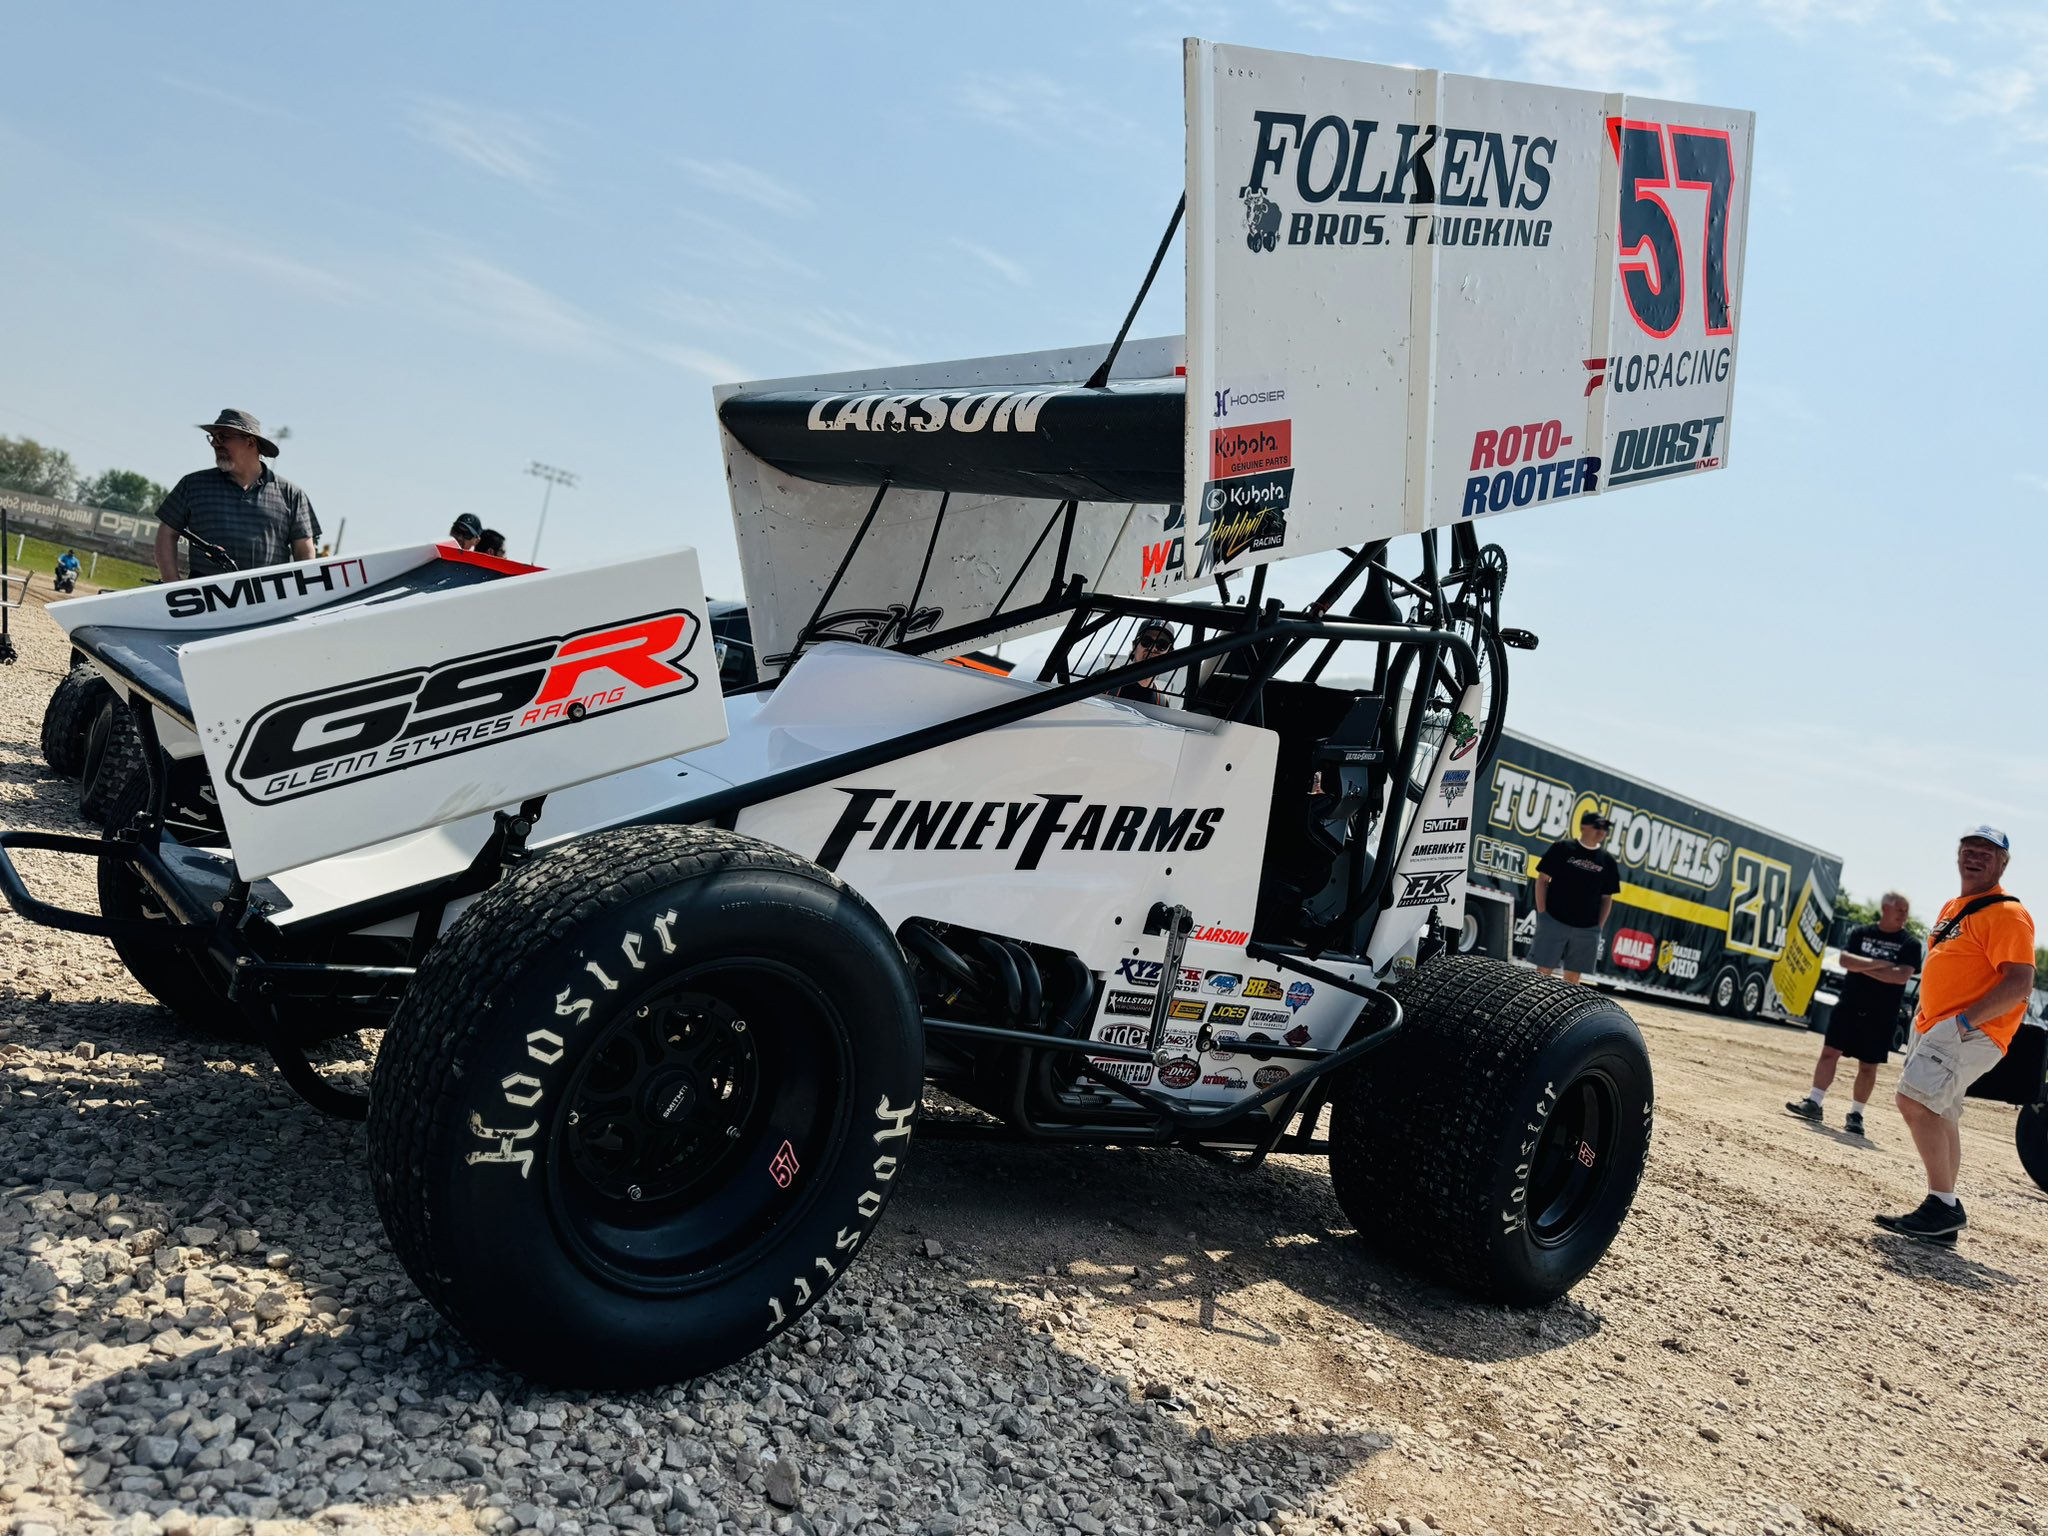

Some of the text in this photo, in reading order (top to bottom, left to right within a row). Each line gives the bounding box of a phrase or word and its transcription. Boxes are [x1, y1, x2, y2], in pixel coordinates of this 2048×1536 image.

[1239, 110, 1558, 211] FOLKENS
[1288, 212, 1391, 246] BROS.
[1606, 117, 1735, 339] 57
[807, 388, 1072, 433] LARSON
[1230, 390, 1286, 407] HOOSIER
[1215, 431, 1277, 458] Kubota
[1469, 419, 1573, 471] ROTO-
[1610, 415, 1725, 475] DURST
[1231, 455, 1289, 473] GENUINE PARTS
[1696, 457, 1719, 470] INC
[1230, 481, 1285, 507] Kubota
[1461, 456, 1601, 517] ROOTER
[1252, 534, 1283, 549] RACING
[239, 615, 686, 780] GSR
[264, 686, 626, 796] GLENN STYRES RACING
[1490, 764, 1575, 840] TUB
[1605, 804, 1728, 888] TOWELS
[1399, 870, 1465, 899] FK
[1727, 848, 1791, 960] 28
[1114, 957, 1165, 984] XYZ
[1668, 957, 1699, 980] OHIO
[1116, 994, 1154, 1006] ALLSTAR
[1212, 1005, 1247, 1019] JOES
[1101, 1025, 1150, 1047] rider
[1168, 1066, 1192, 1077] DMI
[769, 1139, 800, 1189] 57
[1577, 1140, 1597, 1168] 57
